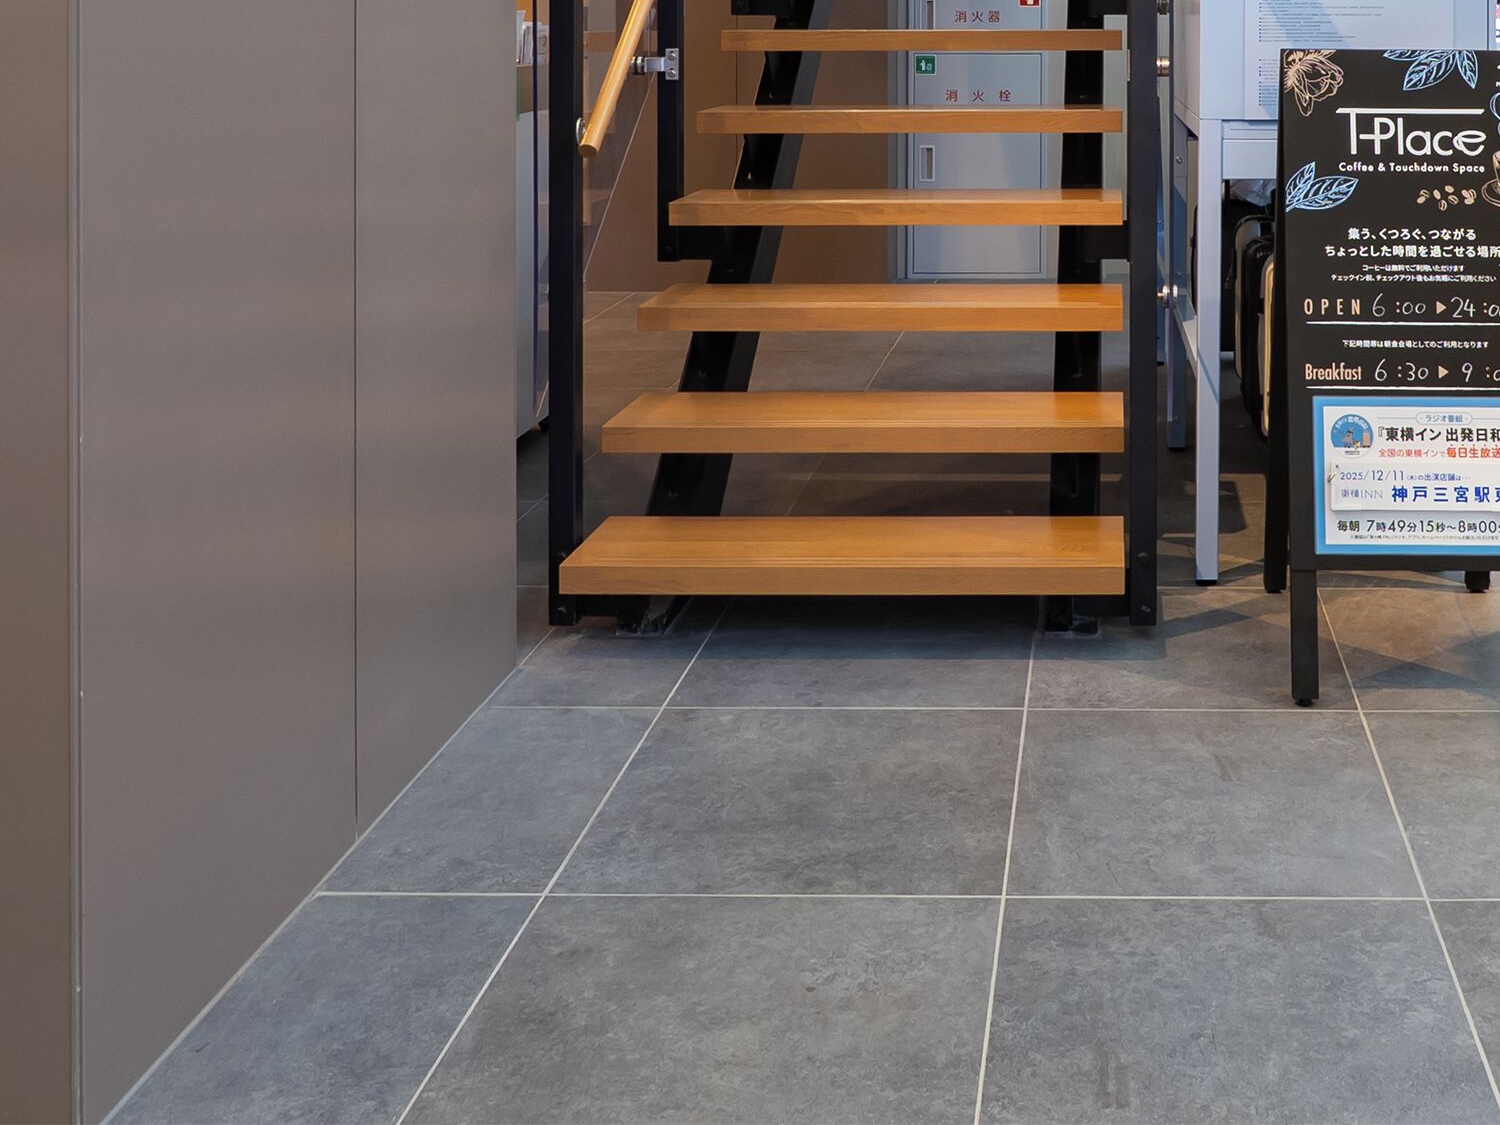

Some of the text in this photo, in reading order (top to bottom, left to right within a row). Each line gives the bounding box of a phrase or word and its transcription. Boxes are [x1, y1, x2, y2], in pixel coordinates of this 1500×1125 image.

[954, 10, 1001, 23] 消火器
[945, 89, 1012, 102] 消火栓
[1338, 162, 1485, 175] Coffee & Touchdown Space
[1348, 228, 1477, 241] 集う、くつろぐ、つながる
[1303, 298, 1361, 315] OPEN
[1305, 362, 1362, 381] Breakfast
[1337, 520, 1360, 533] 毎朝
